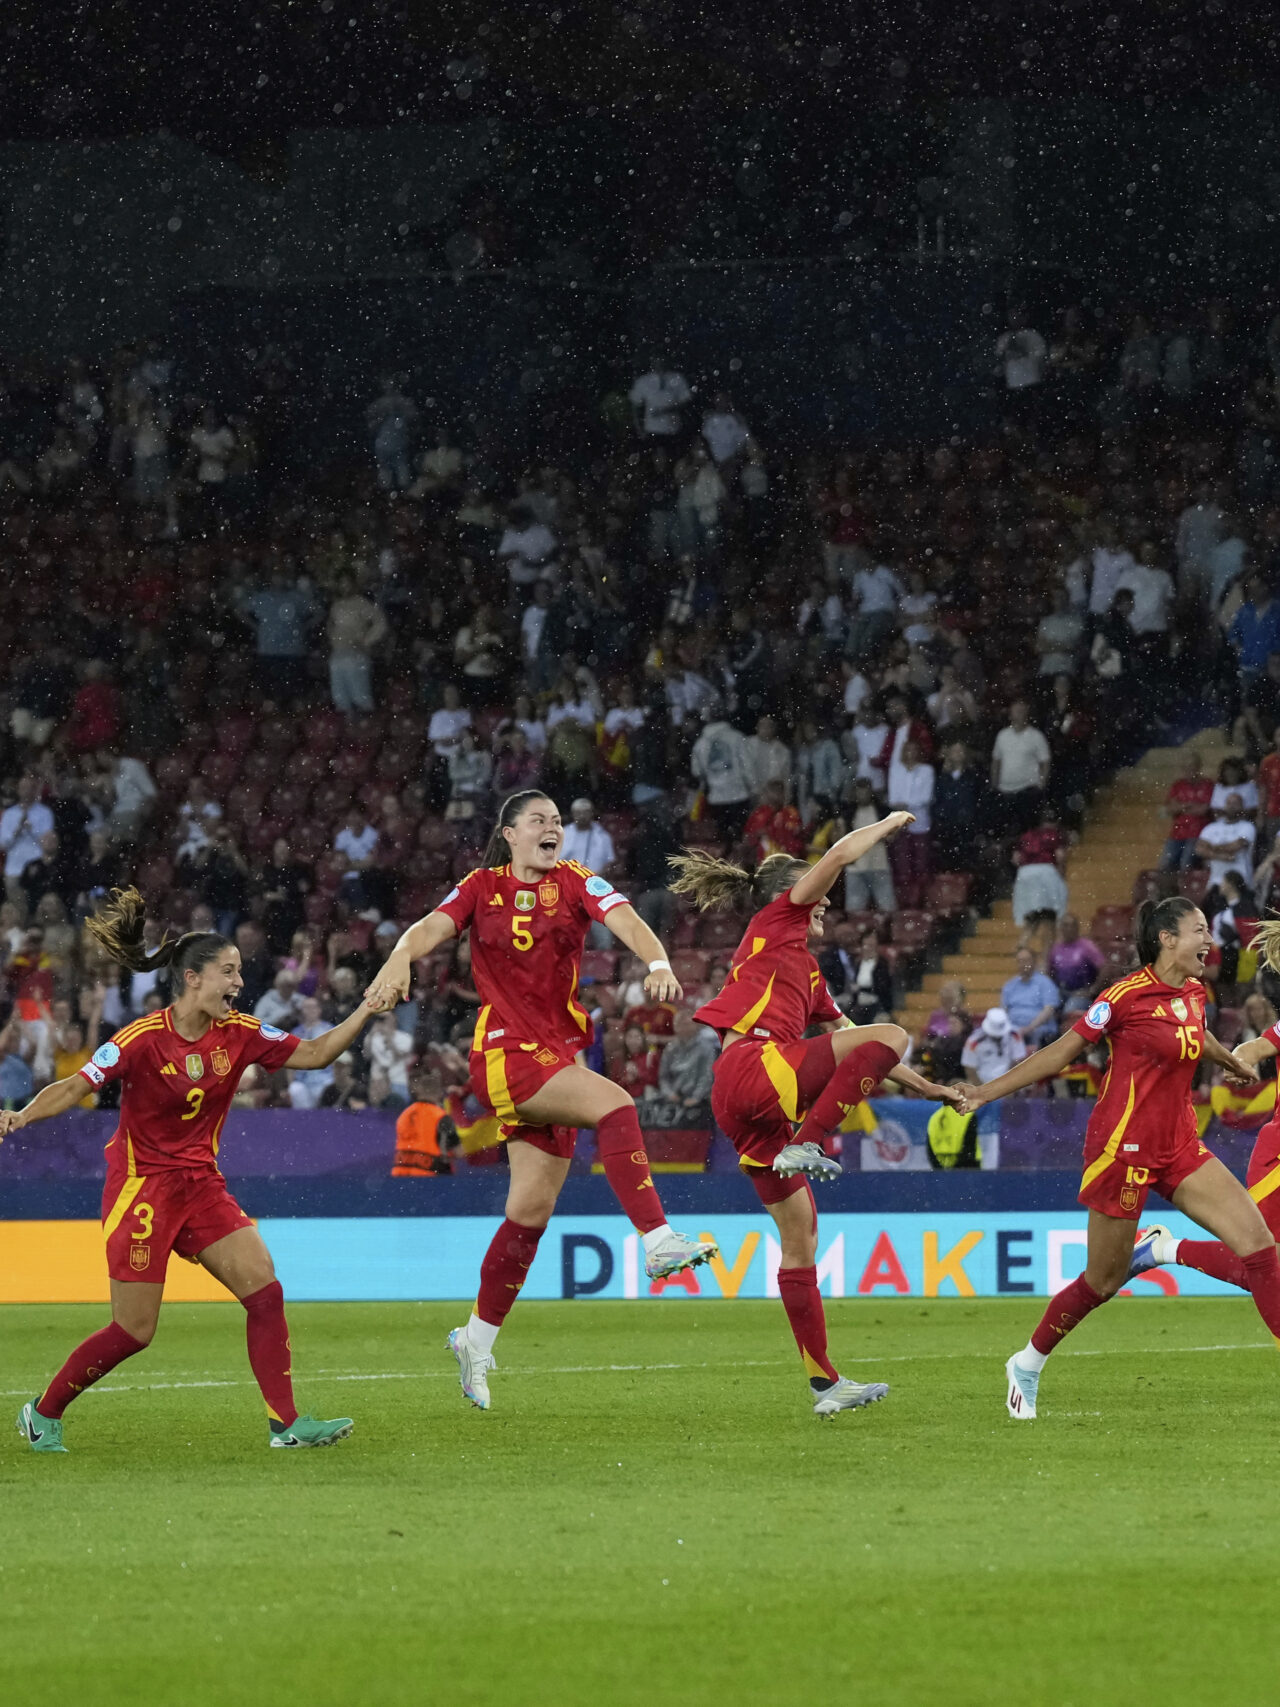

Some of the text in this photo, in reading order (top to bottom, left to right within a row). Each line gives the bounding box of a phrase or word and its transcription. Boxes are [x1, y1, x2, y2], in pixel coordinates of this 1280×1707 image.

[511, 915, 534, 951] 5
[1175, 1026, 1201, 1060] 15
[181, 1088, 205, 1120] 3
[131, 1202, 154, 1240] 3
